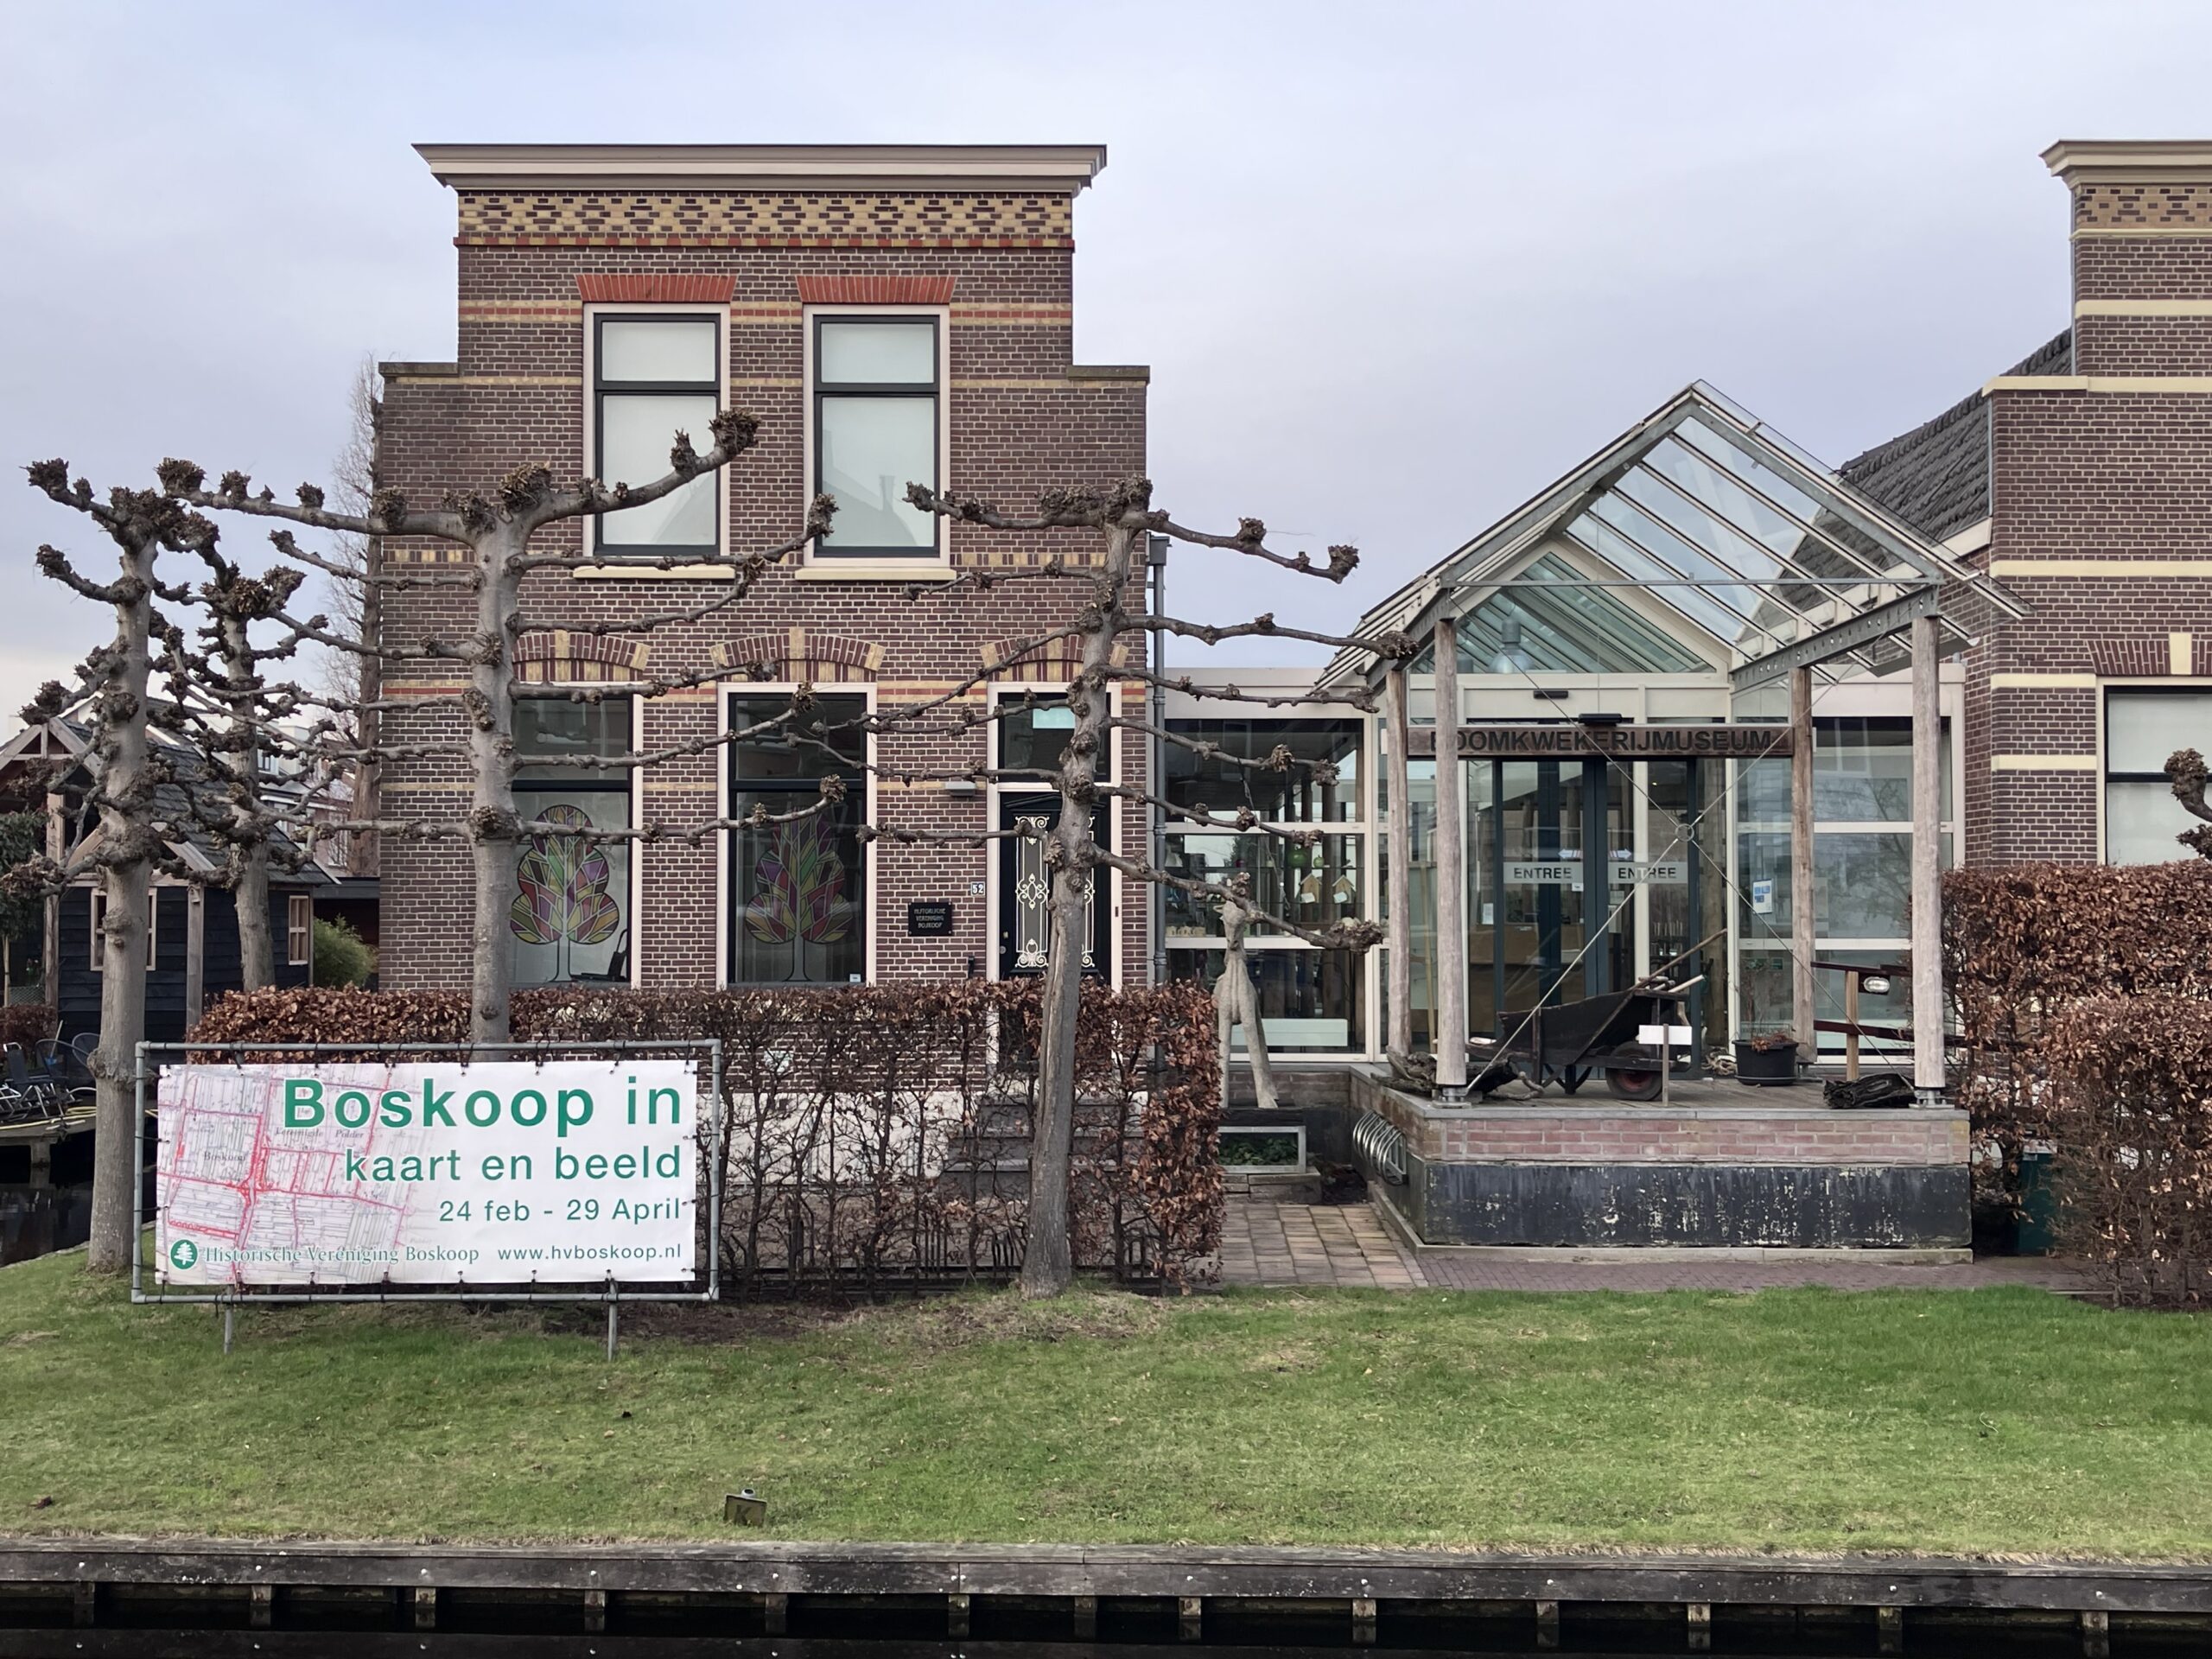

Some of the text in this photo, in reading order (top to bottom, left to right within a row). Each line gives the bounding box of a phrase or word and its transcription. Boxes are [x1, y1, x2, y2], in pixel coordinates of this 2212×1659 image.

[1514, 867, 1573, 880] ENTREE
[1618, 867, 1677, 880] ENTREE
[971, 883, 984, 894] 52
[284, 1075, 682, 1138] Boskoop in
[346, 1145, 682, 1182] kaart en beeld
[439, 1200, 472, 1222] 24
[484, 1199, 531, 1222] feb
[566, 1198, 600, 1220] 29
[611, 1198, 680, 1225] April
[206, 1243, 682, 1265] Historische Vereniging Boskoop www.hvboskoop.nl
